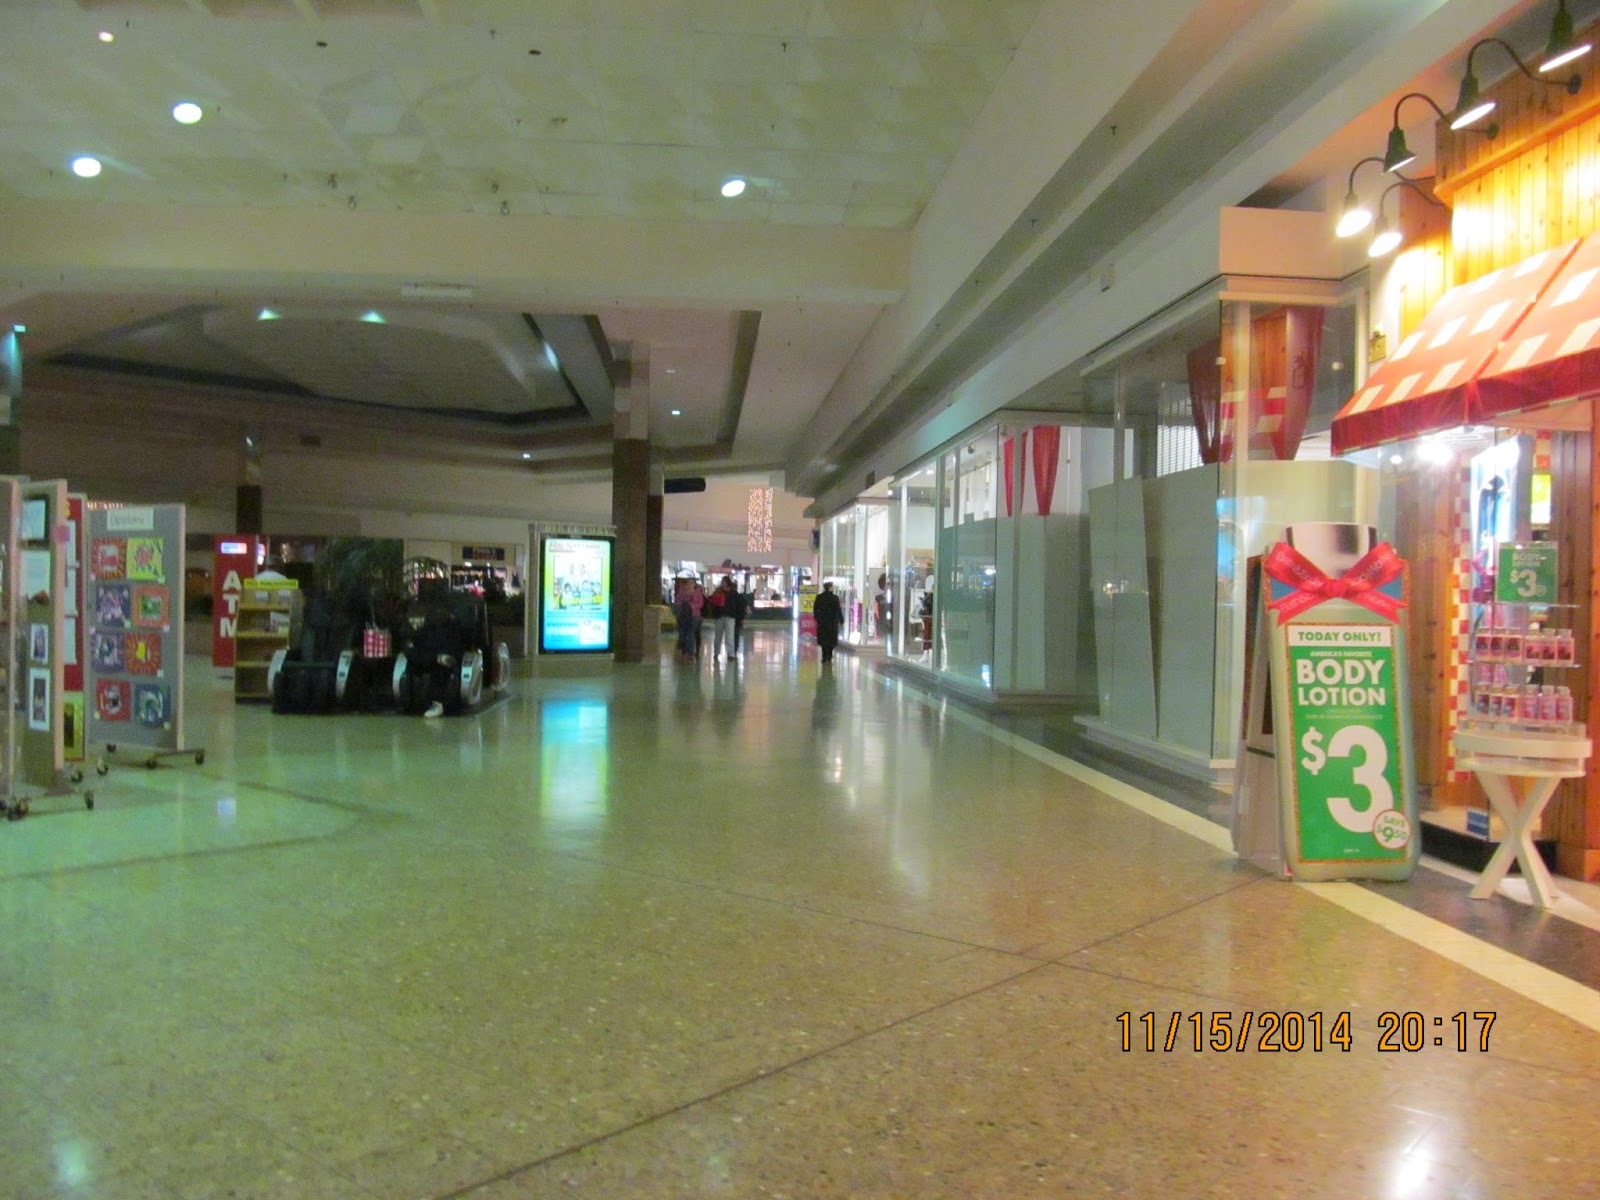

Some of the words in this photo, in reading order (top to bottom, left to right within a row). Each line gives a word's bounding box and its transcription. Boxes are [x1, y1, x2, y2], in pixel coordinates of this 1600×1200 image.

[1298, 631, 1340, 641] TODAY
[1342, 631, 1382, 642] ONLY!
[1296, 658, 1386, 685] BODY
[1298, 686, 1387, 706] LOTION
